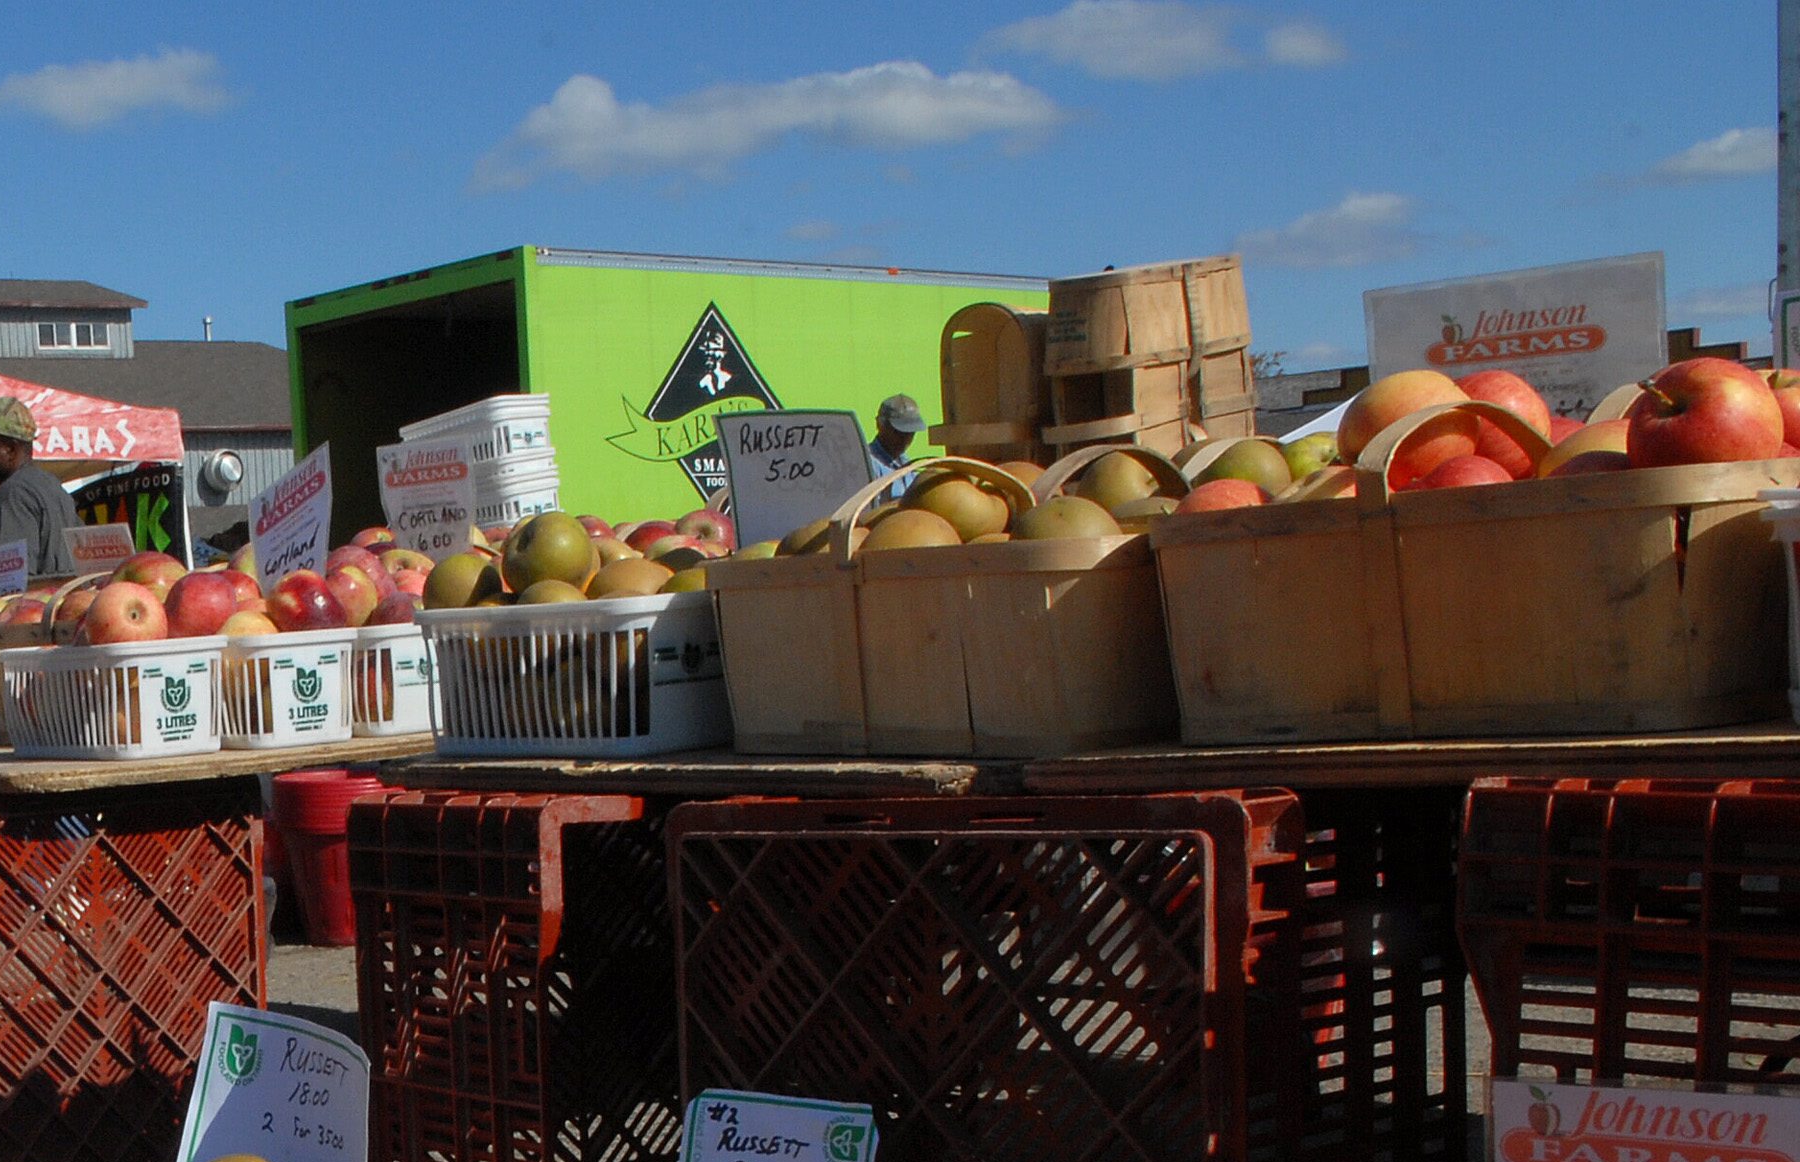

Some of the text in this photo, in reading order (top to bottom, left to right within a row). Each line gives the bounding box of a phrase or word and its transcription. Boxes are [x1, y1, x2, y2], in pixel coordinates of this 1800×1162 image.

[1472, 304, 1587, 339] Johnson
[1443, 331, 1591, 362] FARMS
[740, 422, 824, 456] RUSSETT
[134, 473, 171, 490] FOOD
[393, 467, 461, 485] FARMS
[765, 458, 815, 482] 5.00
[398, 506, 467, 532] CORTLAND
[165, 713, 197, 729] LITRES
[297, 703, 328, 719] LITRES
[280, 1037, 349, 1086] RUSSETT
[262, 1112, 274, 1133] 2
[707, 1102, 740, 1126] #2
[1569, 1090, 1769, 1145] Johnson
[717, 1127, 811, 1158] RUSSETT
